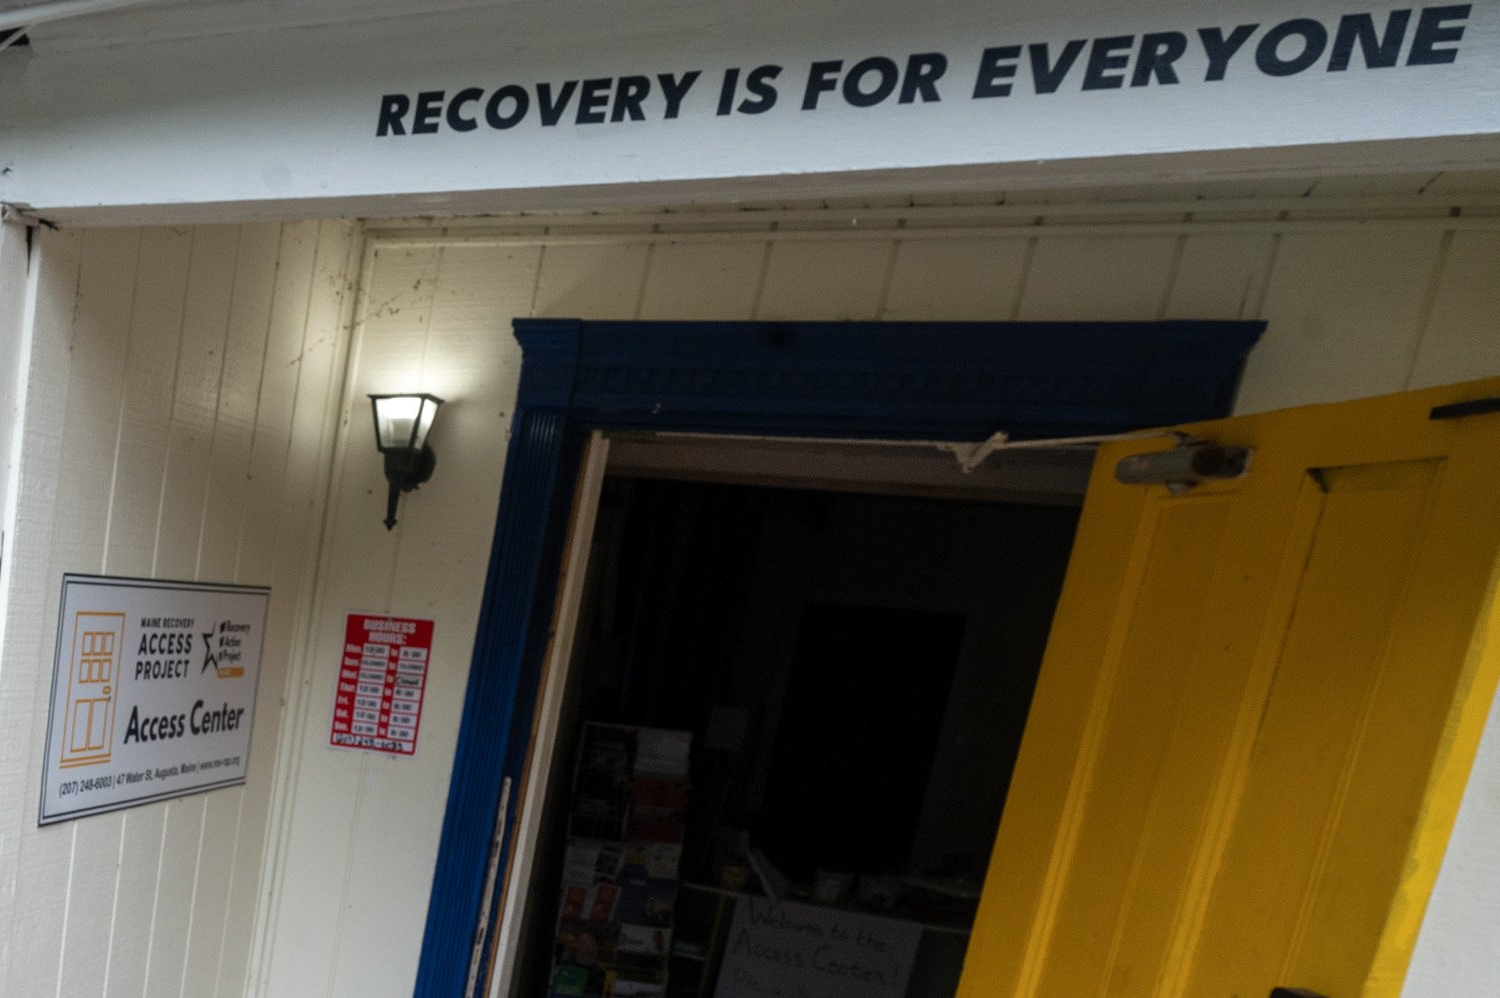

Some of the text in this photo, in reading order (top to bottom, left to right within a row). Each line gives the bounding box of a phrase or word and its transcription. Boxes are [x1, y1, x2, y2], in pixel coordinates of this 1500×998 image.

[376, 4, 1473, 138] RECOVERY IS FOR EVERYONE
[141, 617, 195, 629] MAINE RECOVERY
[138, 633, 193, 655] ACCESS
[135, 660, 190, 680] PROJECT
[124, 700, 244, 744] Access Center
[116, 774, 125, 786] 47
